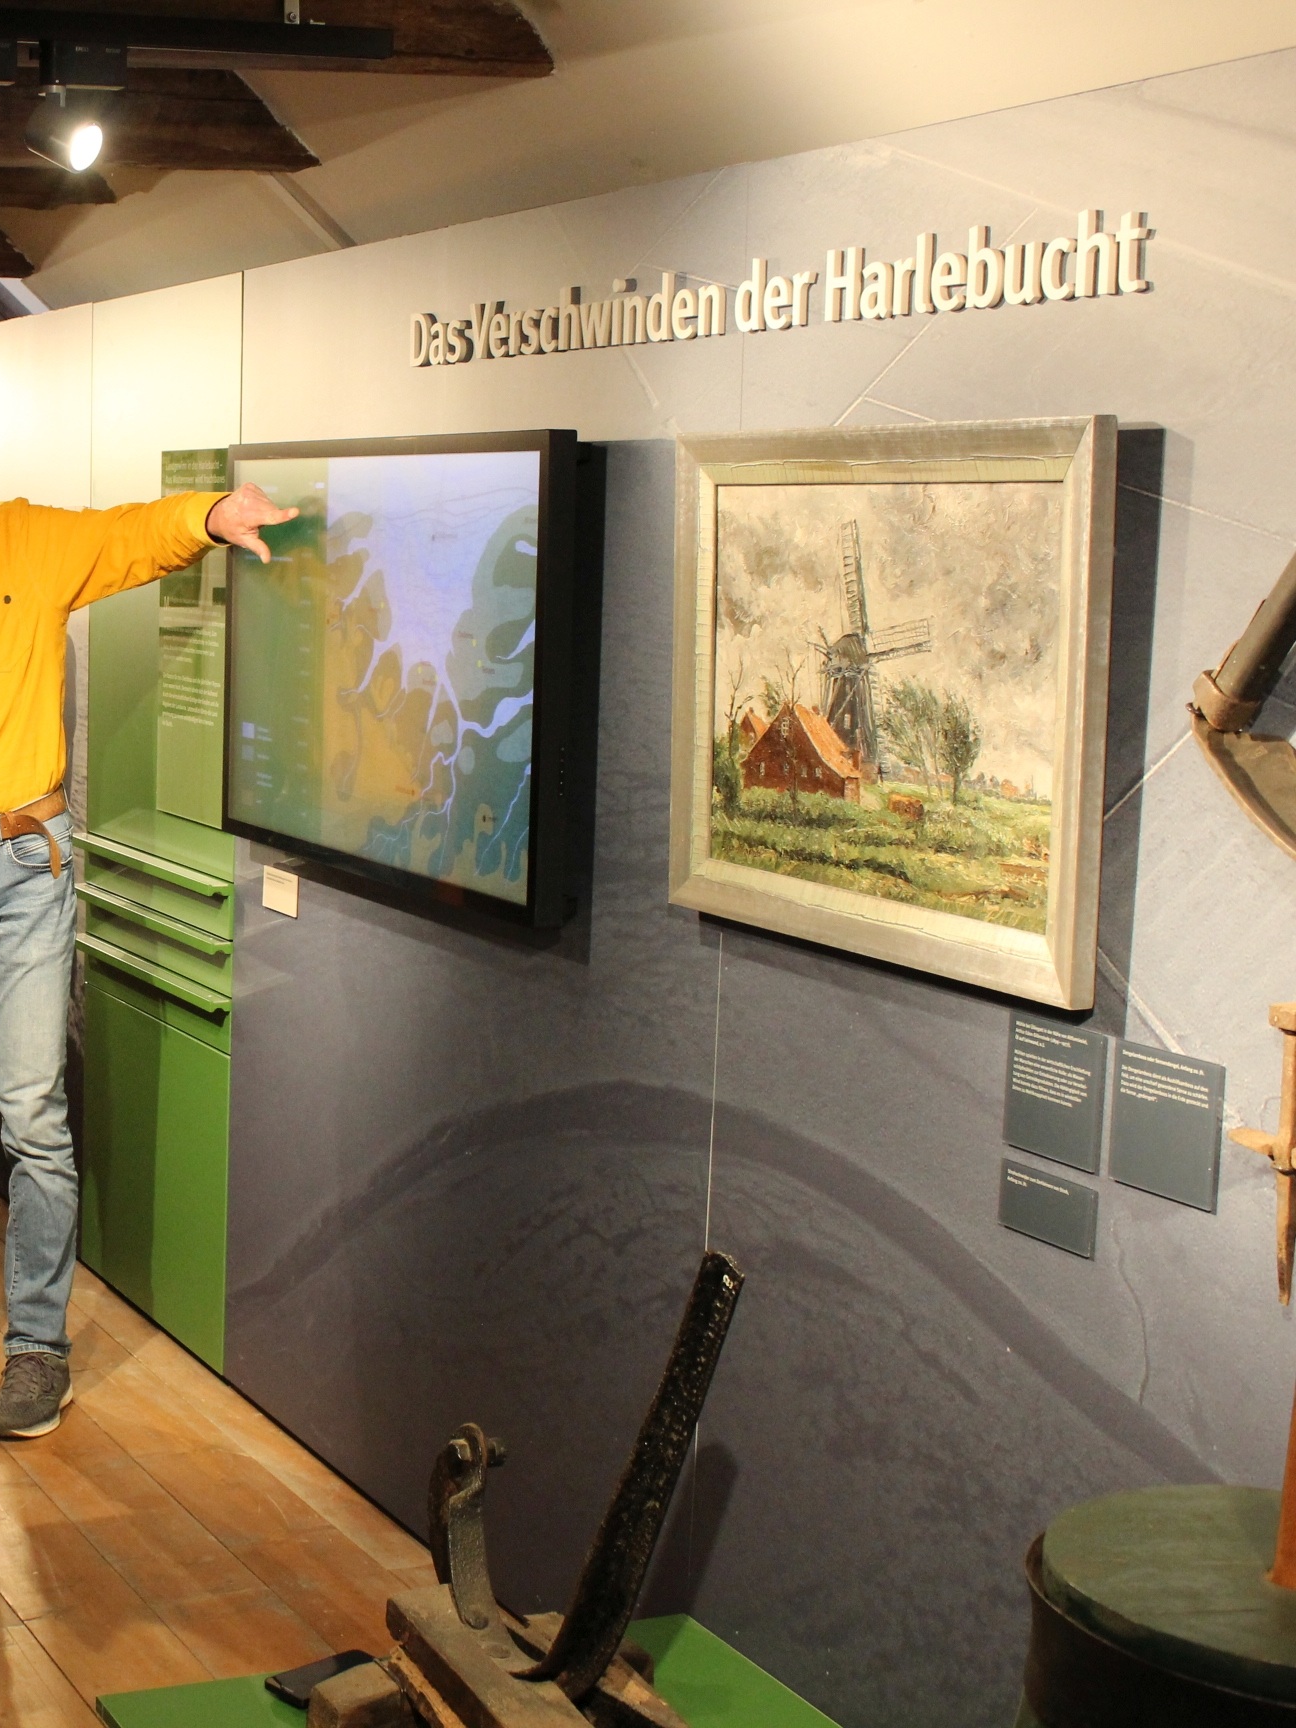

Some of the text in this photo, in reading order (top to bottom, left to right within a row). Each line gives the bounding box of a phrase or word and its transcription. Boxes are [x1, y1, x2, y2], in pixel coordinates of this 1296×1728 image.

[410, 209, 1156, 367] Das Verschwinden der Harlebucht
